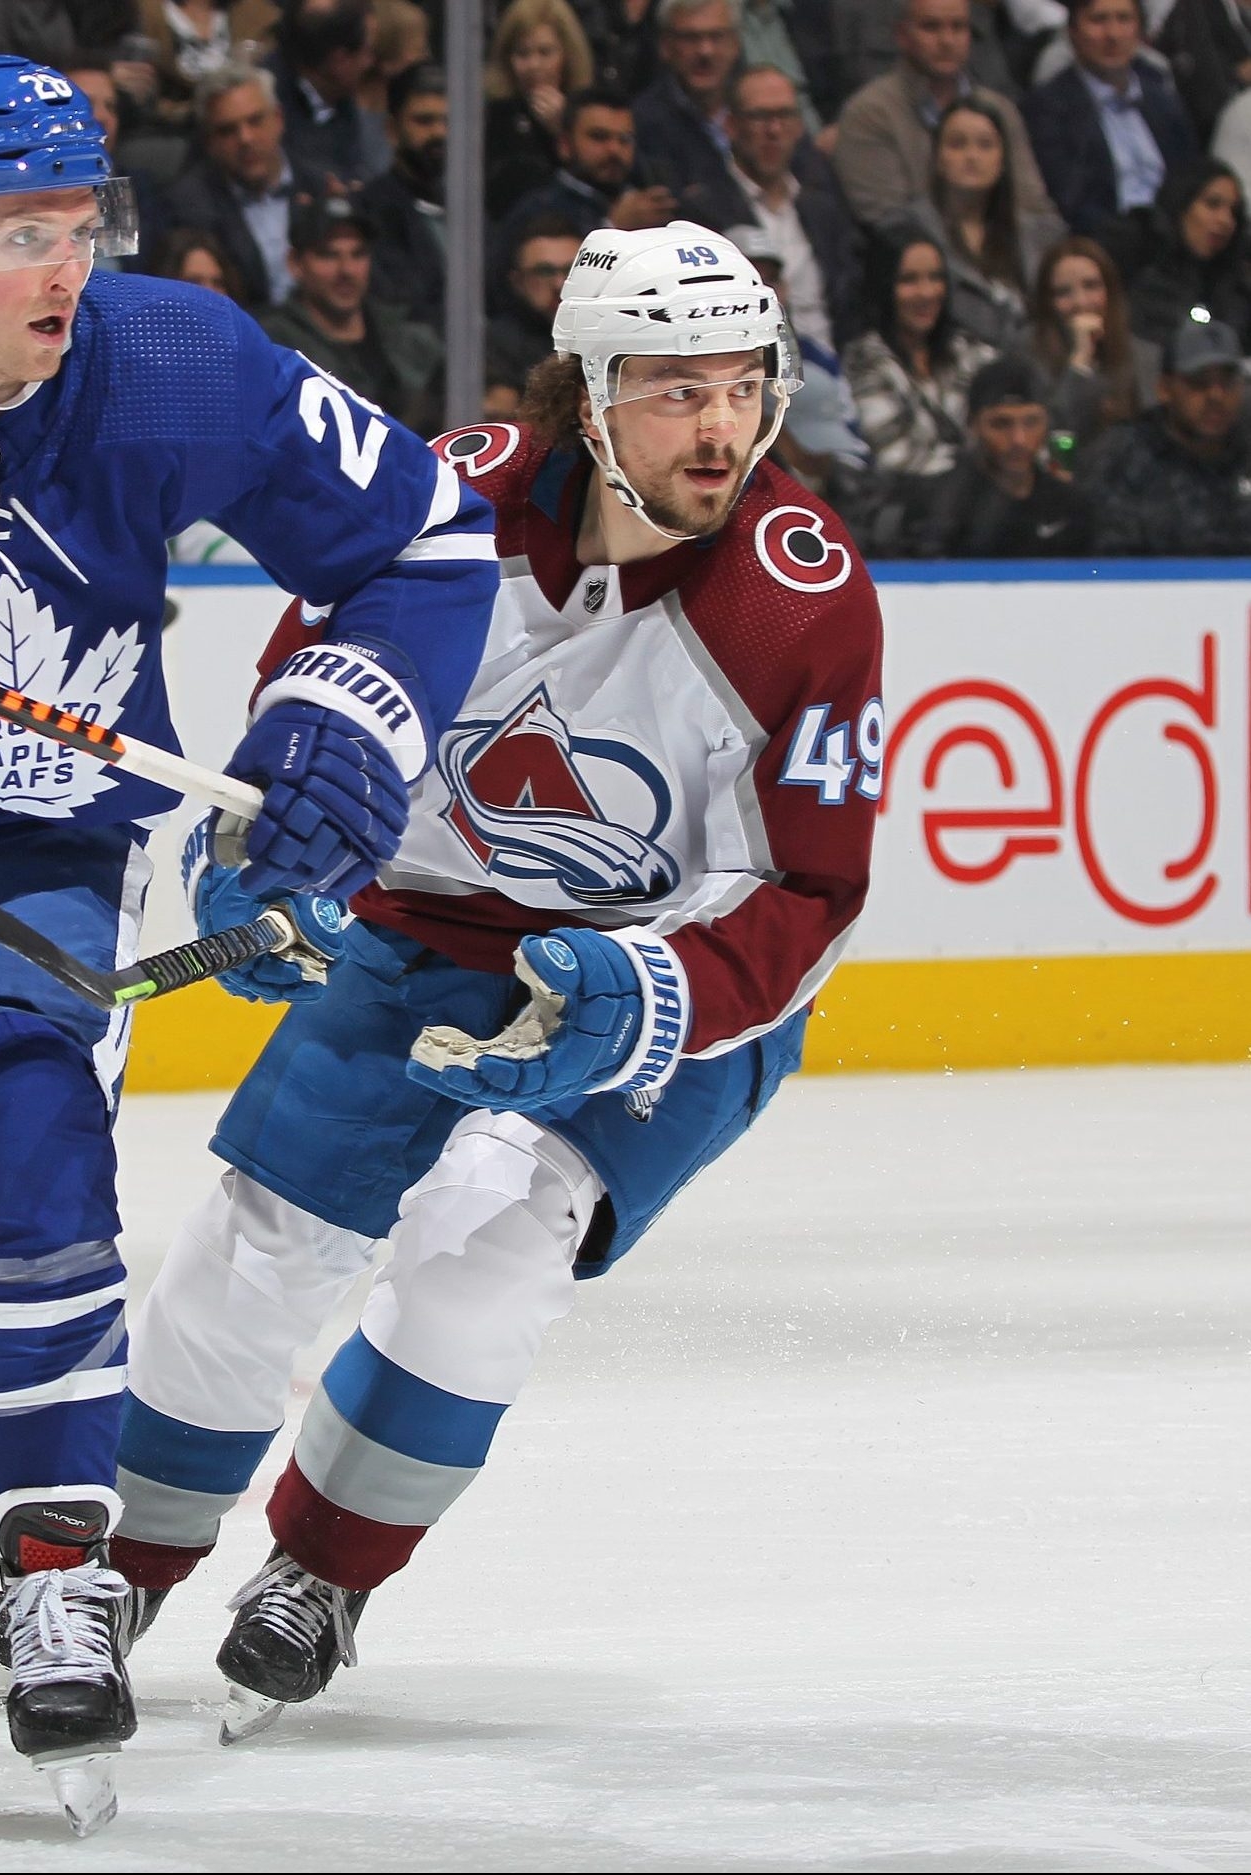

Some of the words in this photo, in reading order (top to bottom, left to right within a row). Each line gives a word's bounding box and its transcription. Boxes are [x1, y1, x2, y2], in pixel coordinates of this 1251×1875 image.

[676, 246, 720, 267] 49
[687, 303, 749, 320] CCM
[298, 351, 391, 490] 2
[337, 641, 380, 660] LAFFERTY
[283, 732, 300, 770] ALPHA
[778, 697, 885, 806] 49
[42, 1508, 87, 1527] VAPOR
